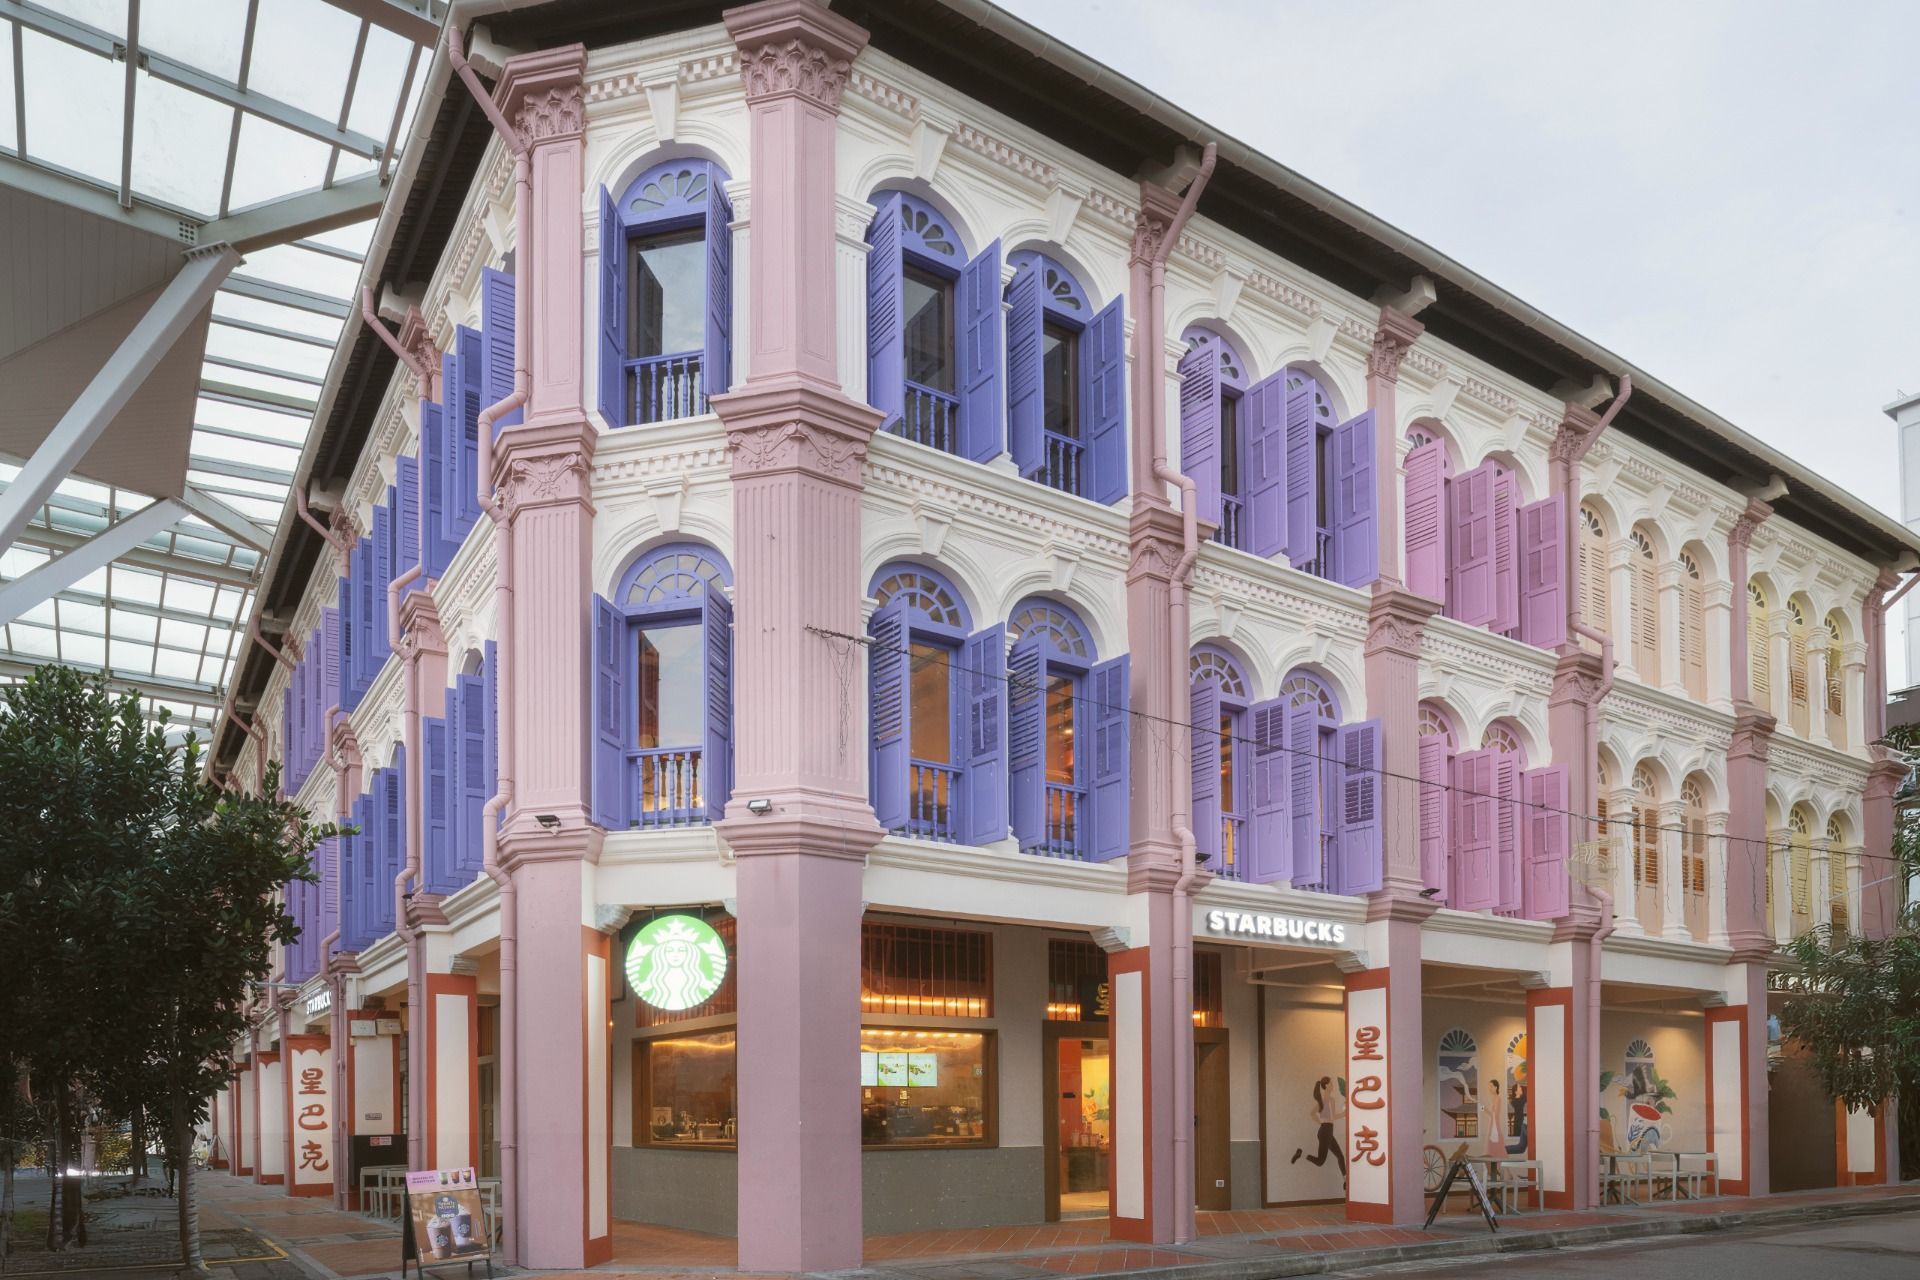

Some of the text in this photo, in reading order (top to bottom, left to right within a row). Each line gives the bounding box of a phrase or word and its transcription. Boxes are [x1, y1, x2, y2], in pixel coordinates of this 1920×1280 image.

[1209, 910, 1345, 943] STARBUCKS
[306, 991, 332, 1015] STARBUCK
[298, 1067, 329, 1172] 星巴克
[1351, 1025, 1386, 1167] 星巴克
